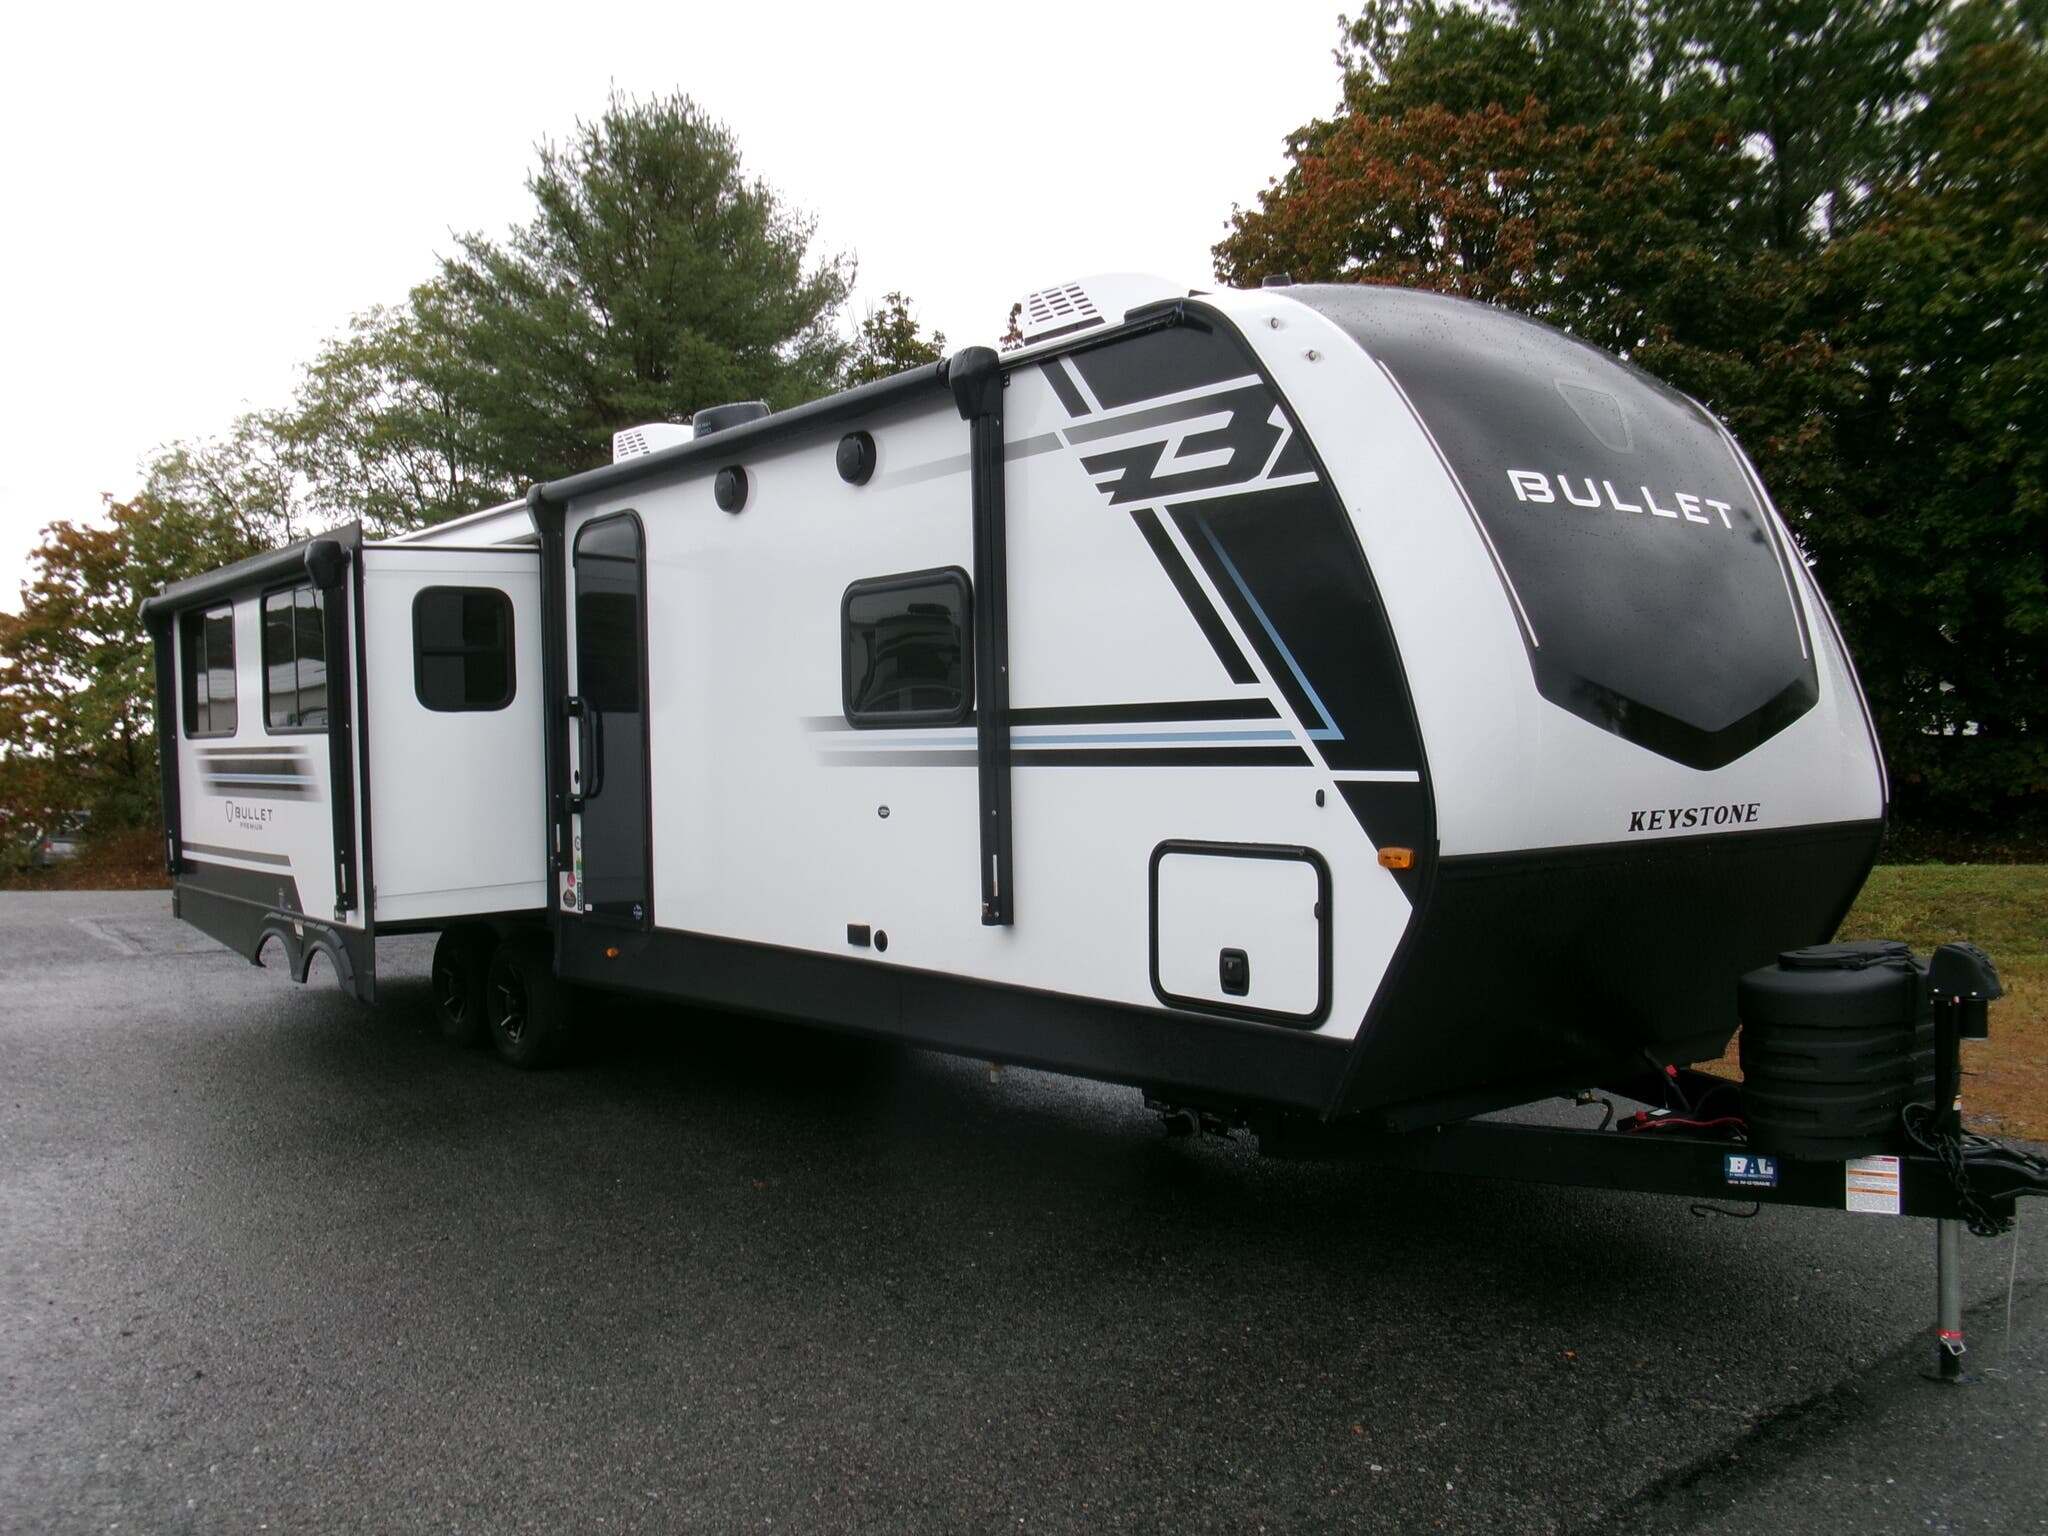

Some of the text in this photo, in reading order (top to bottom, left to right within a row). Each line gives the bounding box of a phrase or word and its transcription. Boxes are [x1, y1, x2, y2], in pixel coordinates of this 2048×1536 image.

[1507, 469, 1732, 529] BULLET
[235, 806, 273, 821] BULLET
[1628, 802, 1761, 832] KEYSTONE
[1729, 1156, 1774, 1175] BAL
